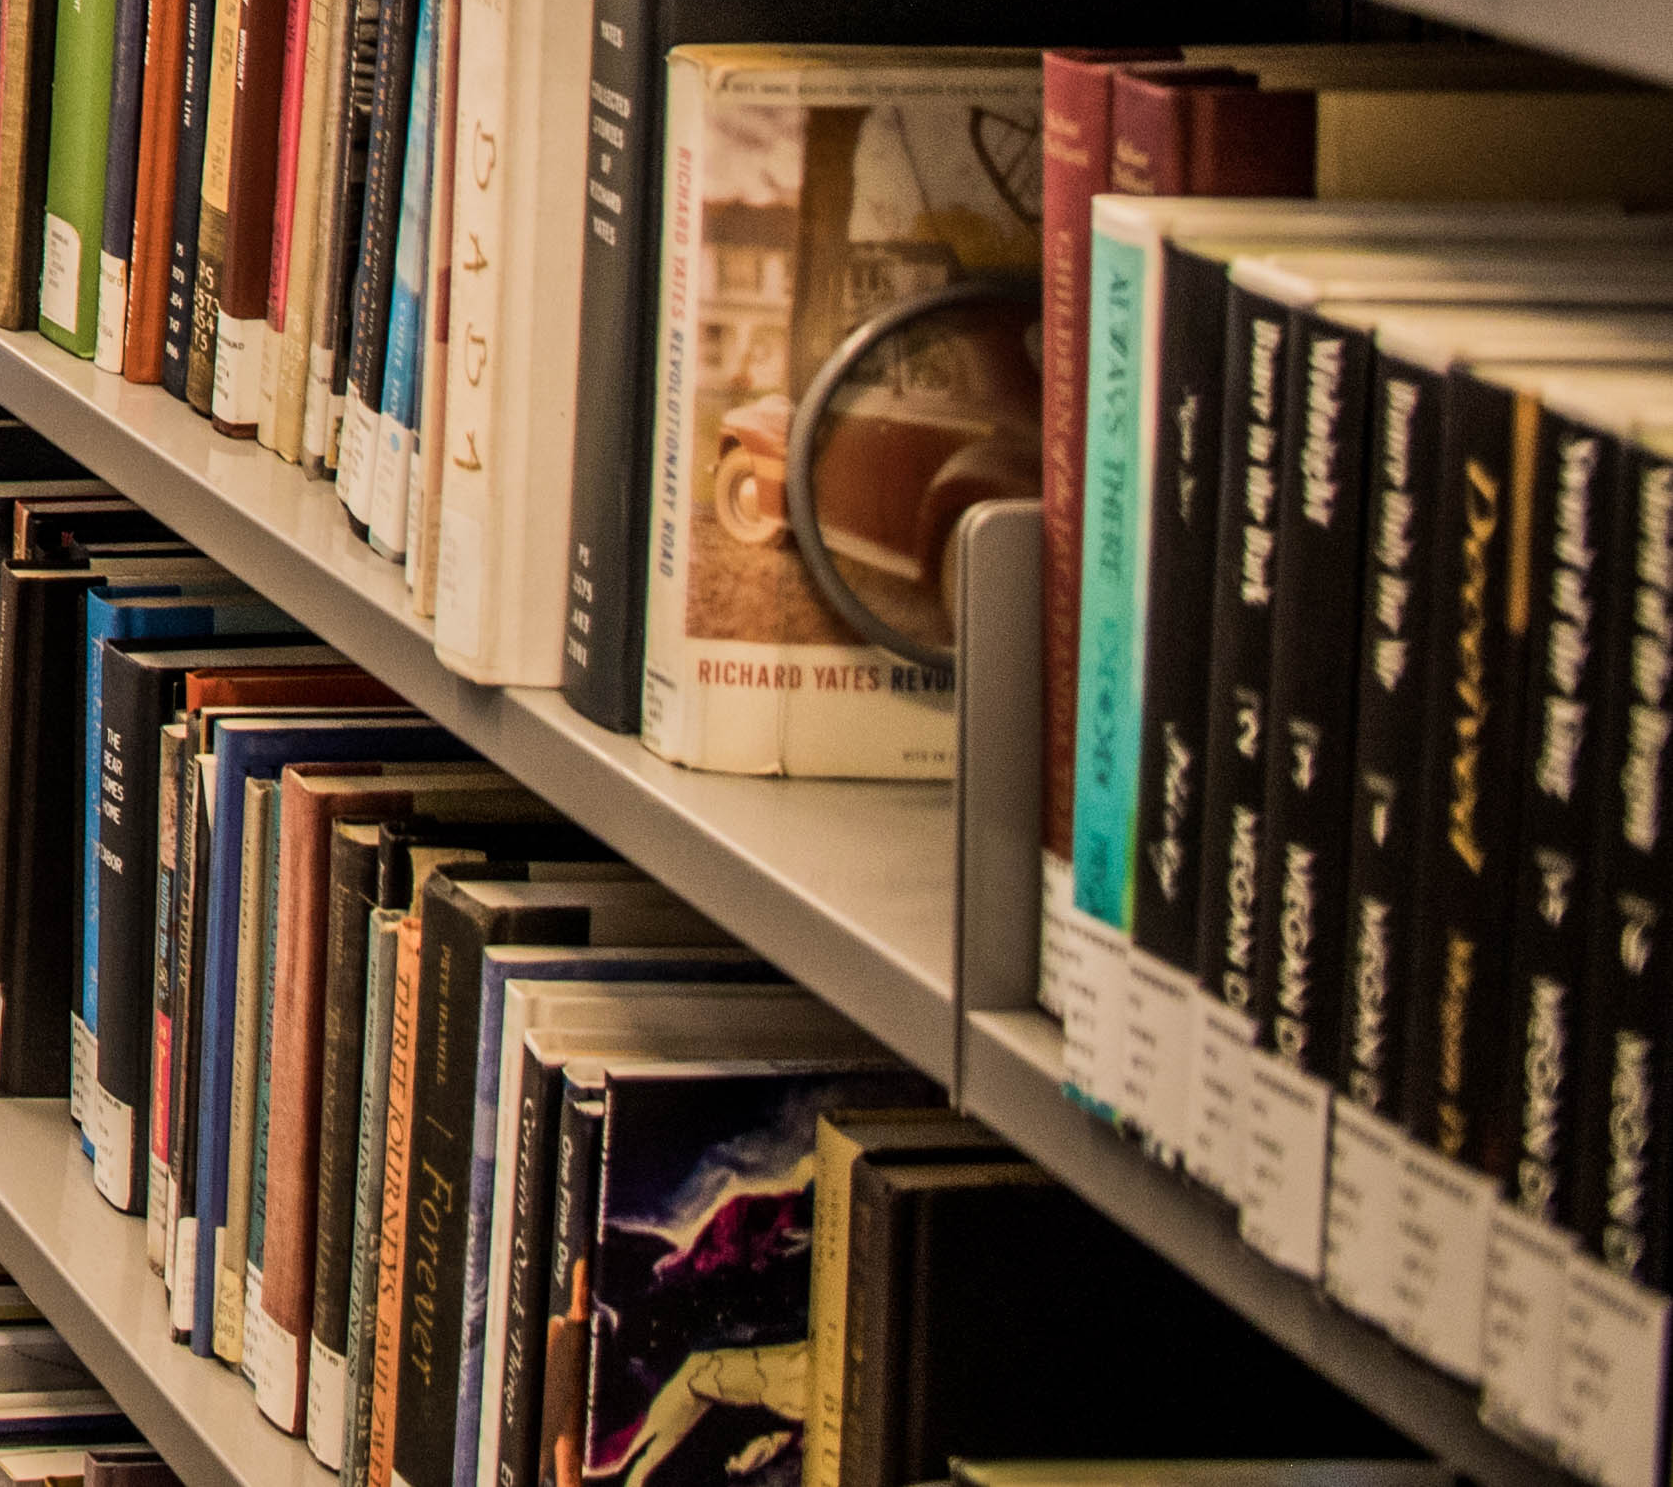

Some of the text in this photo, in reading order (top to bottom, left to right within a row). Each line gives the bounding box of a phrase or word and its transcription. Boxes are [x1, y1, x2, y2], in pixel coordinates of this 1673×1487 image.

[236, 29, 250, 91] WRONSKY
[658, 146, 692, 578] RICHARD YATES REVOLUTIONARY ROAD
[698, 659, 880, 692] RICHARD YATES
[1226, 805, 1257, 968] MEGAN
[1277, 842, 1313, 1015] MEGAN
[390, 973, 412, 1095] THREE
[378, 1099, 408, 1302] JOURNEYS
[411, 1157, 454, 1387] Forever
[554, 1135, 573, 1289] One Fine Day
[375, 1318, 391, 1394] PAUL
